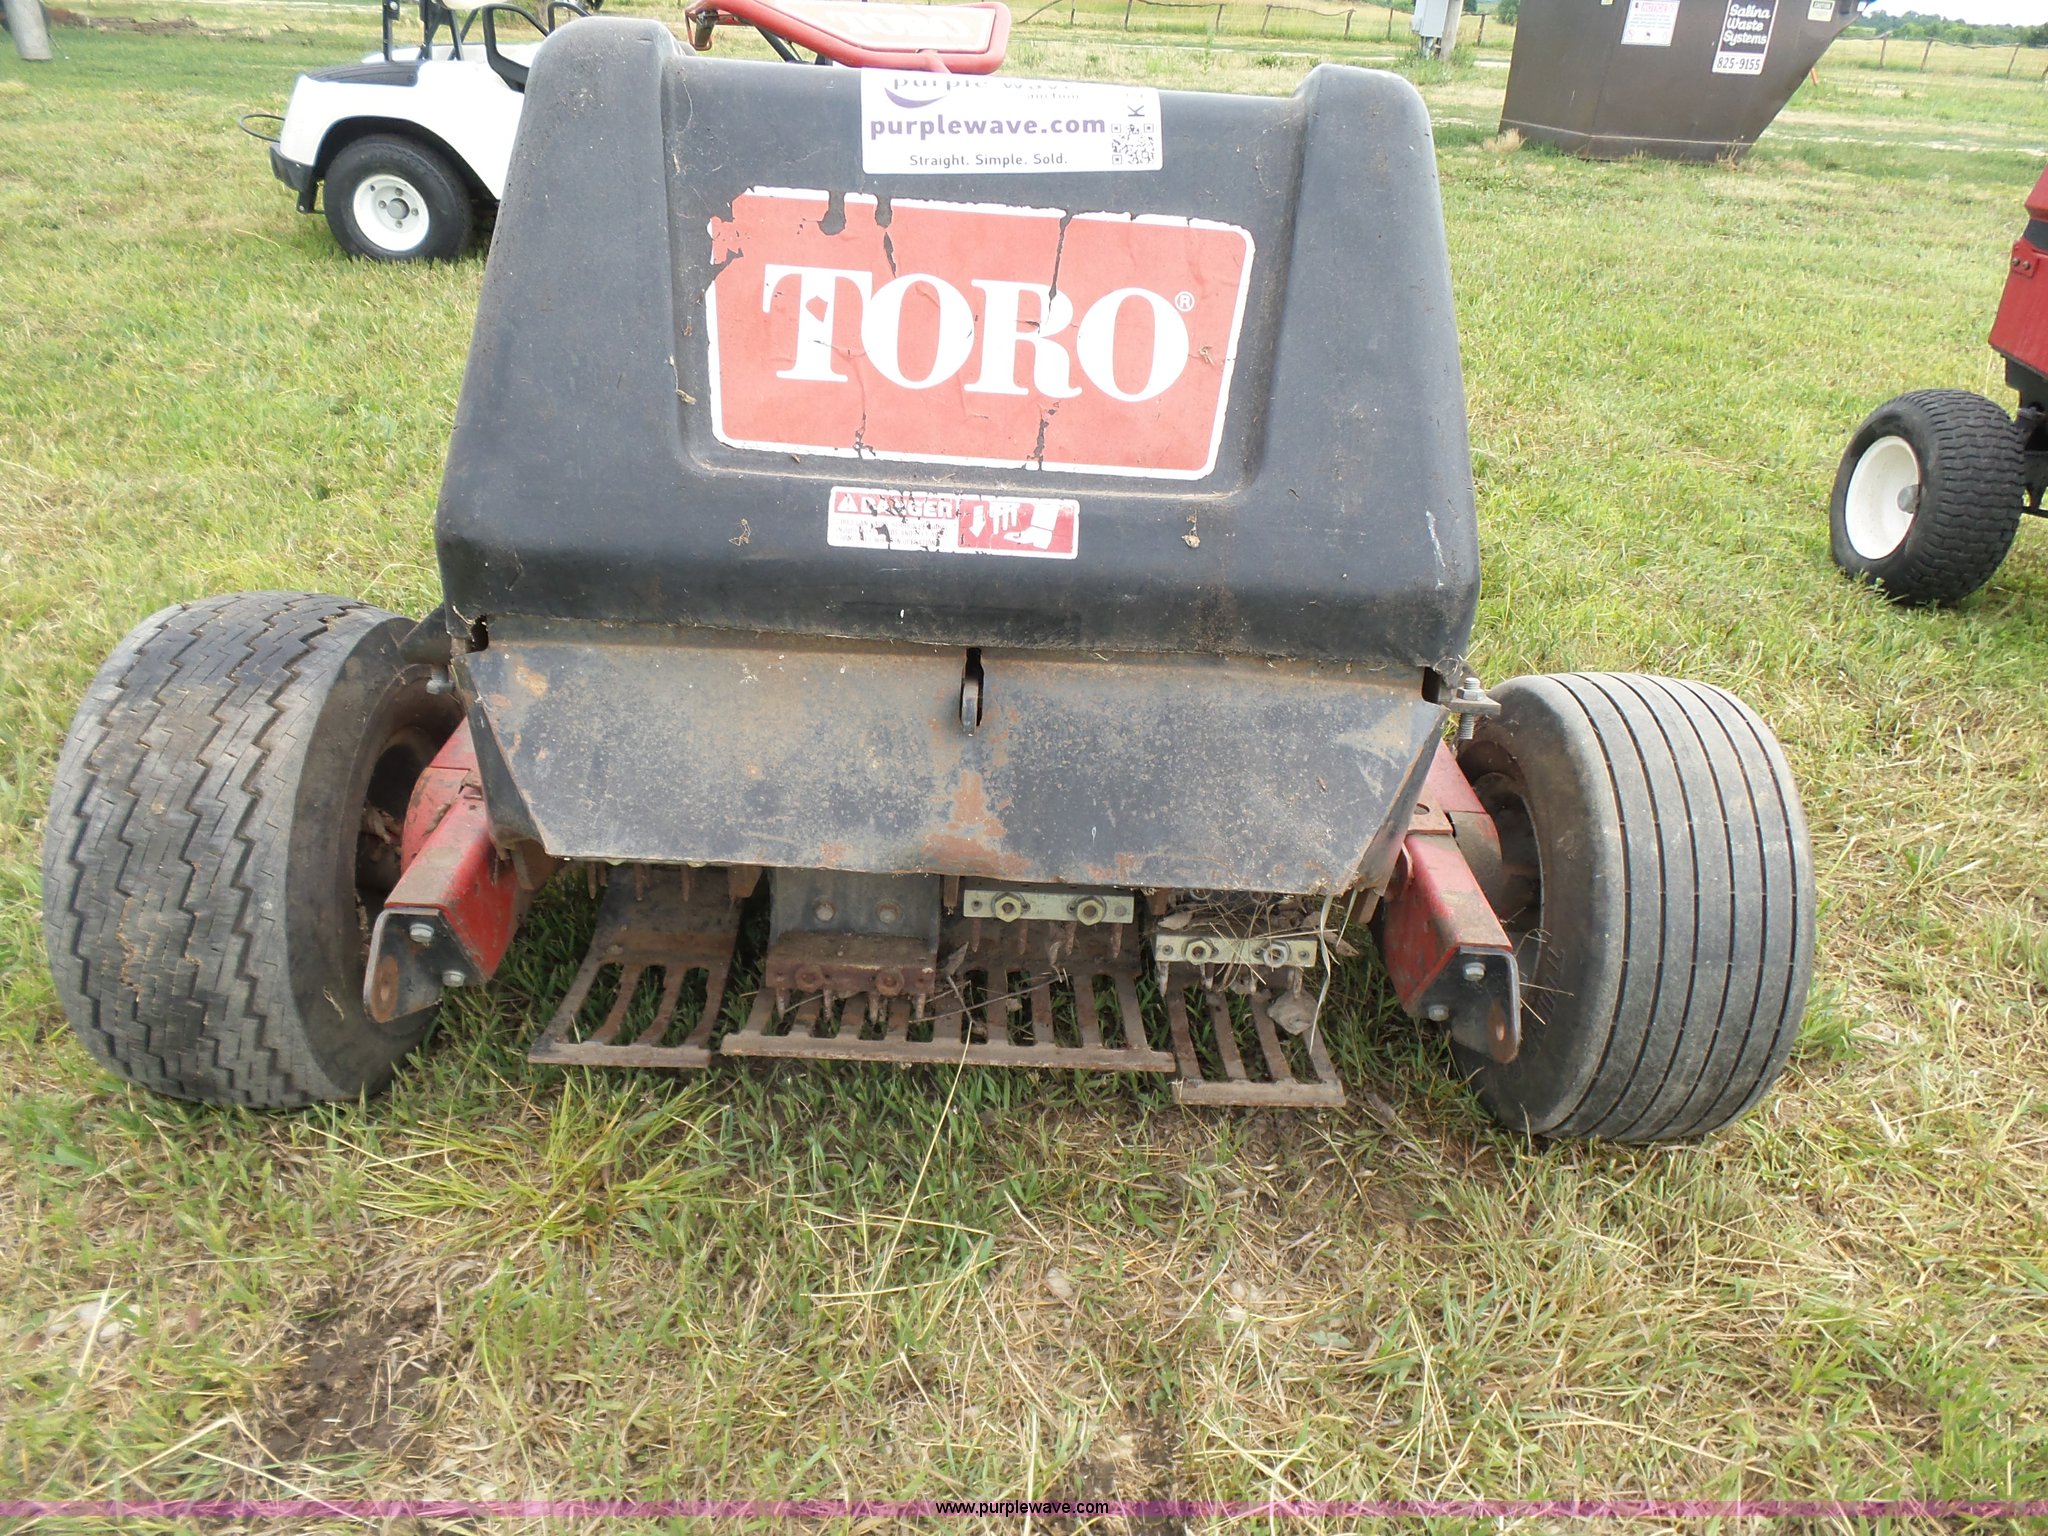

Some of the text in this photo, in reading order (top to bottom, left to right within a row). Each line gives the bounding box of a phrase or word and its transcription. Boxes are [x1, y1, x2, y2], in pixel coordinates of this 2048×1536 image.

[1729, 4, 1771, 19] Salina
[1726, 17, 1764, 31] Waste
[1723, 30, 1767, 46] Systems
[1716, 57, 1761, 71] 825-9155
[870, 114, 1106, 140] purplewave.com
[909, 153, 1068, 168] Straight. Simple. Sold.
